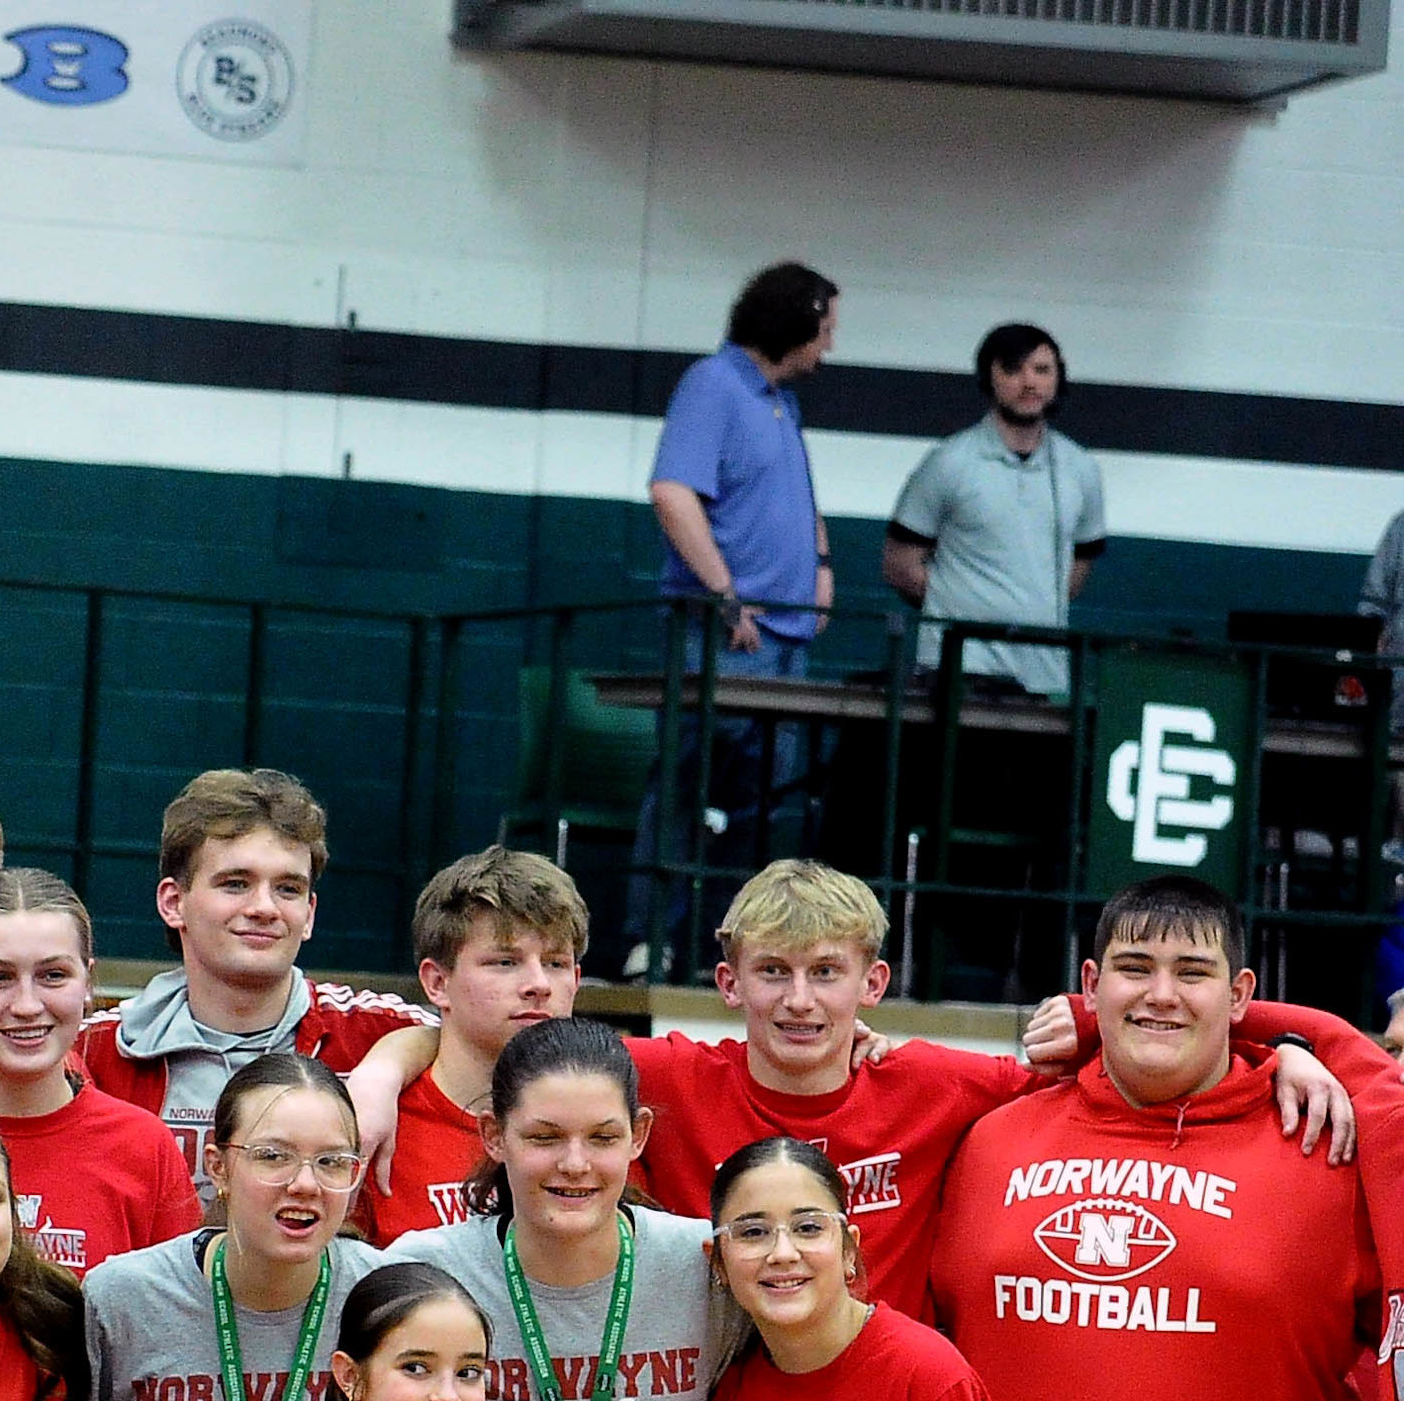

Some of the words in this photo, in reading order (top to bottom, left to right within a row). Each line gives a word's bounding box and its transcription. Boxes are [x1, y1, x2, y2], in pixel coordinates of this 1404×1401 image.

[1005, 1157, 1237, 1219] NORWAYNE
[1076, 1212, 1133, 1266] N
[995, 1275, 1217, 1334] FOOTBALL
